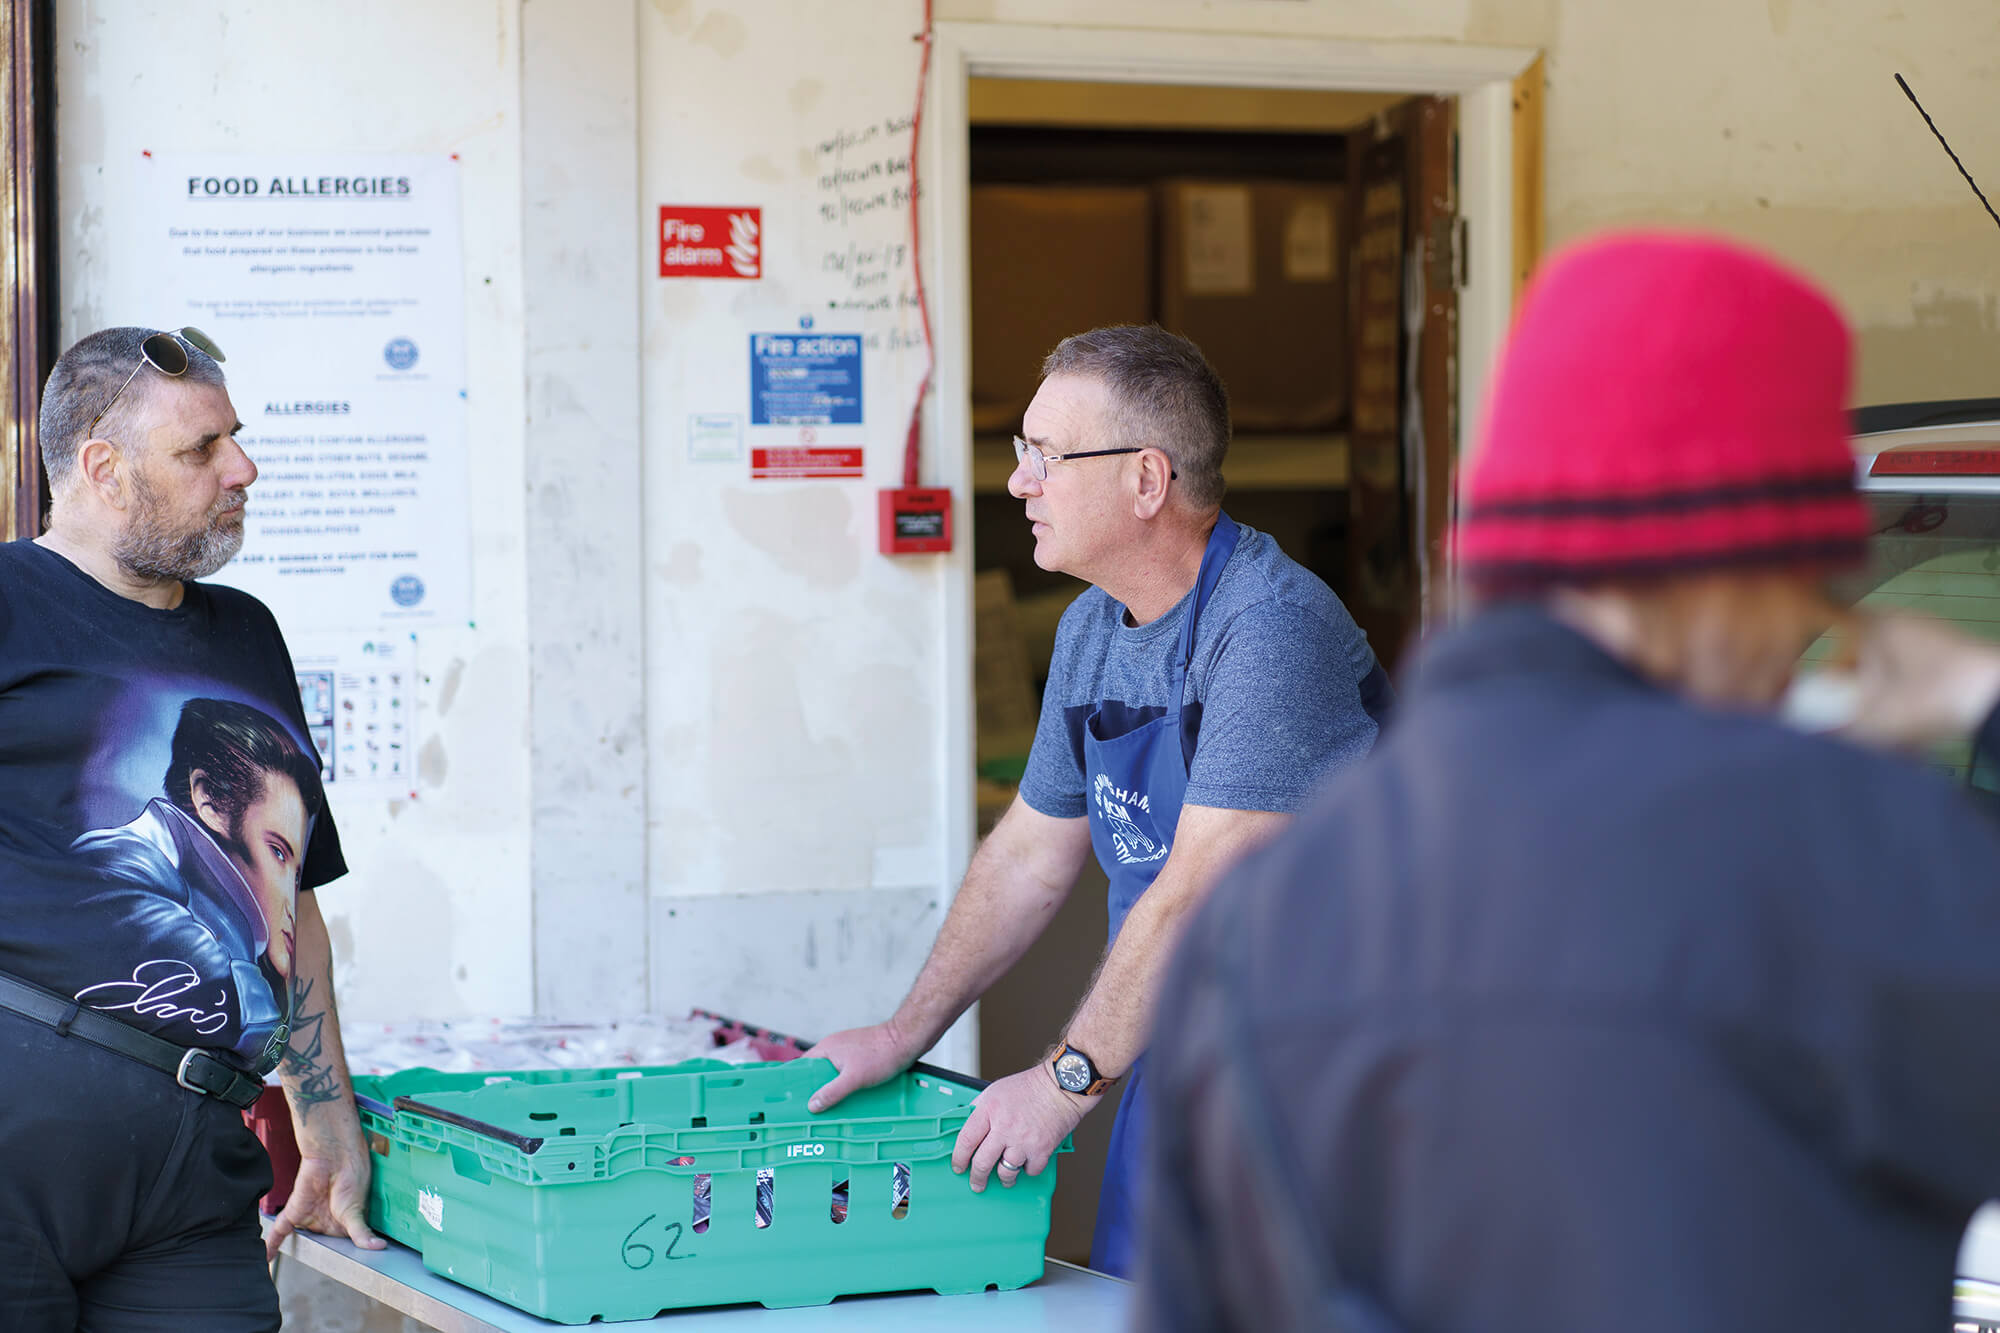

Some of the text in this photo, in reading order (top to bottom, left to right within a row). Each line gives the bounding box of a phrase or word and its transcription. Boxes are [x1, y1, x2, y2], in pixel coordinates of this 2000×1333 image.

[188, 176, 411, 196] FOOD ALLERGIES
[664, 219, 704, 241] Fire
[664, 244, 723, 266] alarm
[755, 337, 794, 356] Fire
[797, 337, 858, 356] action
[264, 401, 351, 413] ALLERGIES
[787, 1143, 825, 1157] IFCO
[621, 1214, 697, 1270] 62
